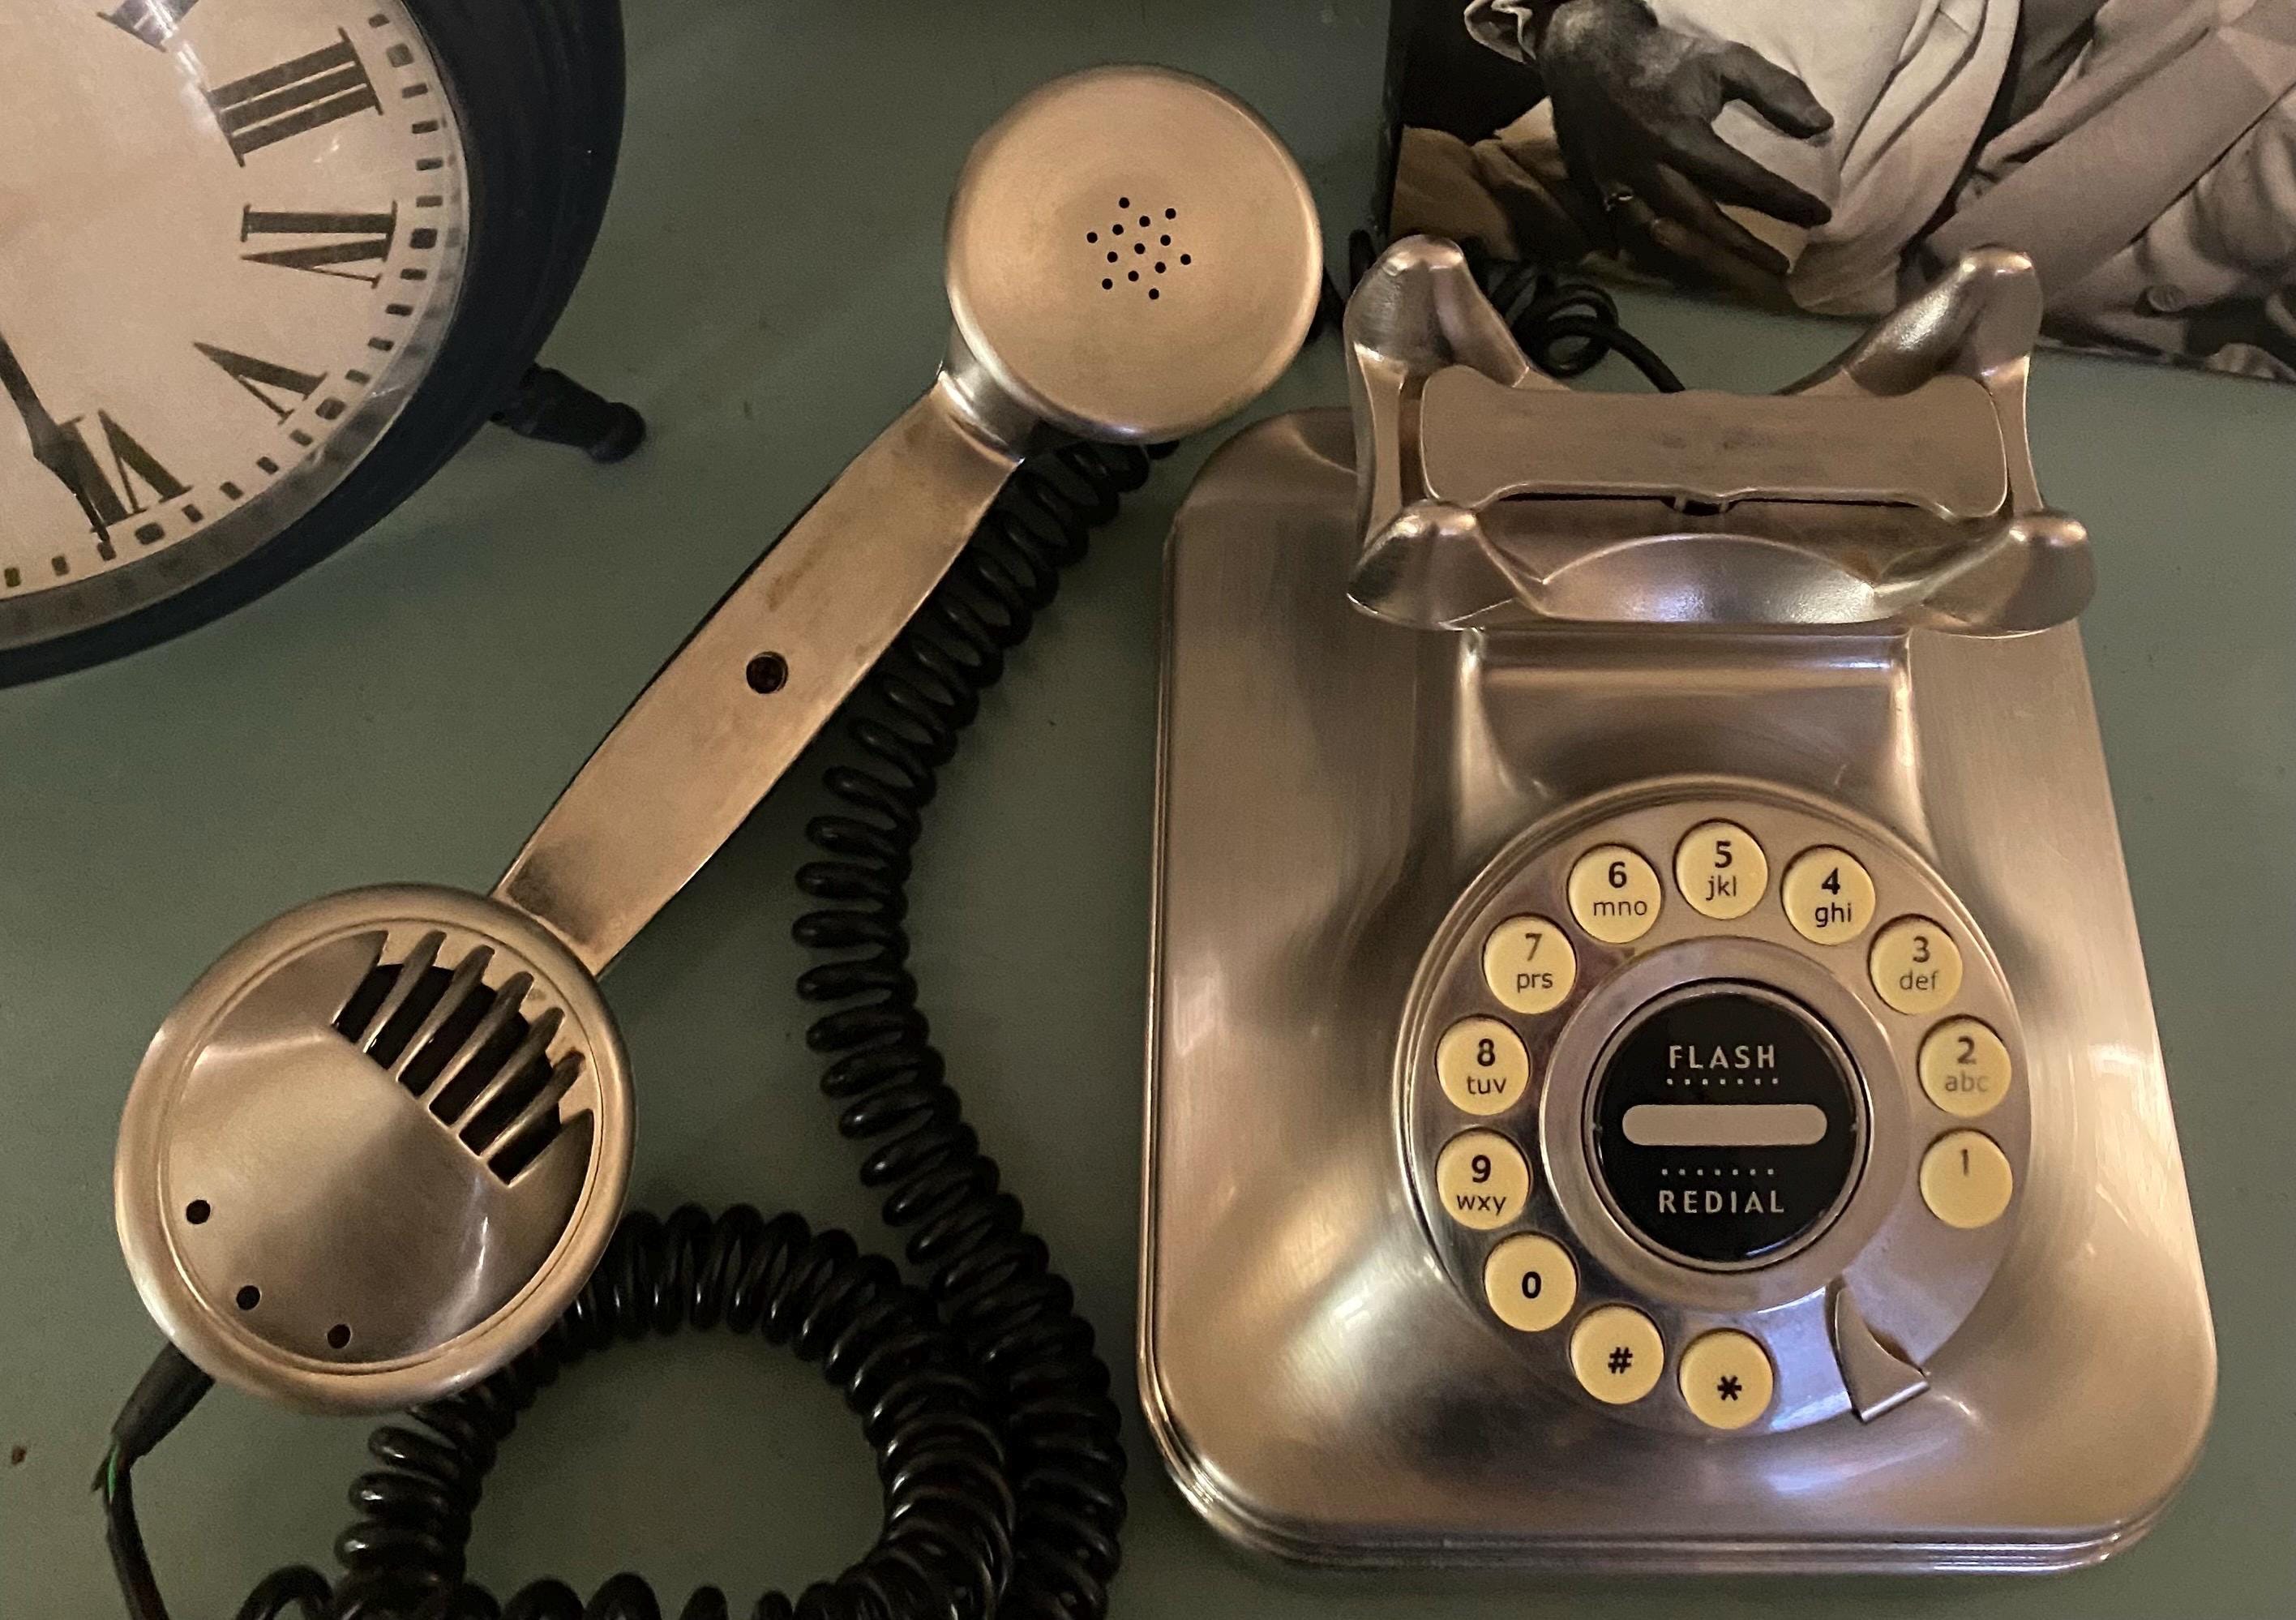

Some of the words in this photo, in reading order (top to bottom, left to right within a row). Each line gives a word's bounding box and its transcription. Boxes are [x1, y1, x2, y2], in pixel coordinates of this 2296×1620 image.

[1715, 840, 1733, 868] 5
[1608, 861, 1627, 889] 6
[1821, 867, 1841, 895] 4
[1705, 875, 1737, 902] jkl
[1593, 900, 1647, 916] mno
[1814, 902, 1852, 928] ghi
[1525, 932, 1543, 961] 7
[1913, 936, 1930, 963] 3
[1517, 972, 1553, 993] prs
[1899, 969, 1938, 992] def
[1477, 1038, 1496, 1067] 8
[1669, 1044, 1775, 1069] FLASH
[1957, 1035, 1975, 1065] 2
[1467, 1076, 1506, 1095] tuv
[1944, 1072, 1988, 1094] abc
[1471, 1154, 1492, 1184] 9
[1456, 1194, 1506, 1216] wxy
[1659, 1189, 1784, 1214] REDIAL
